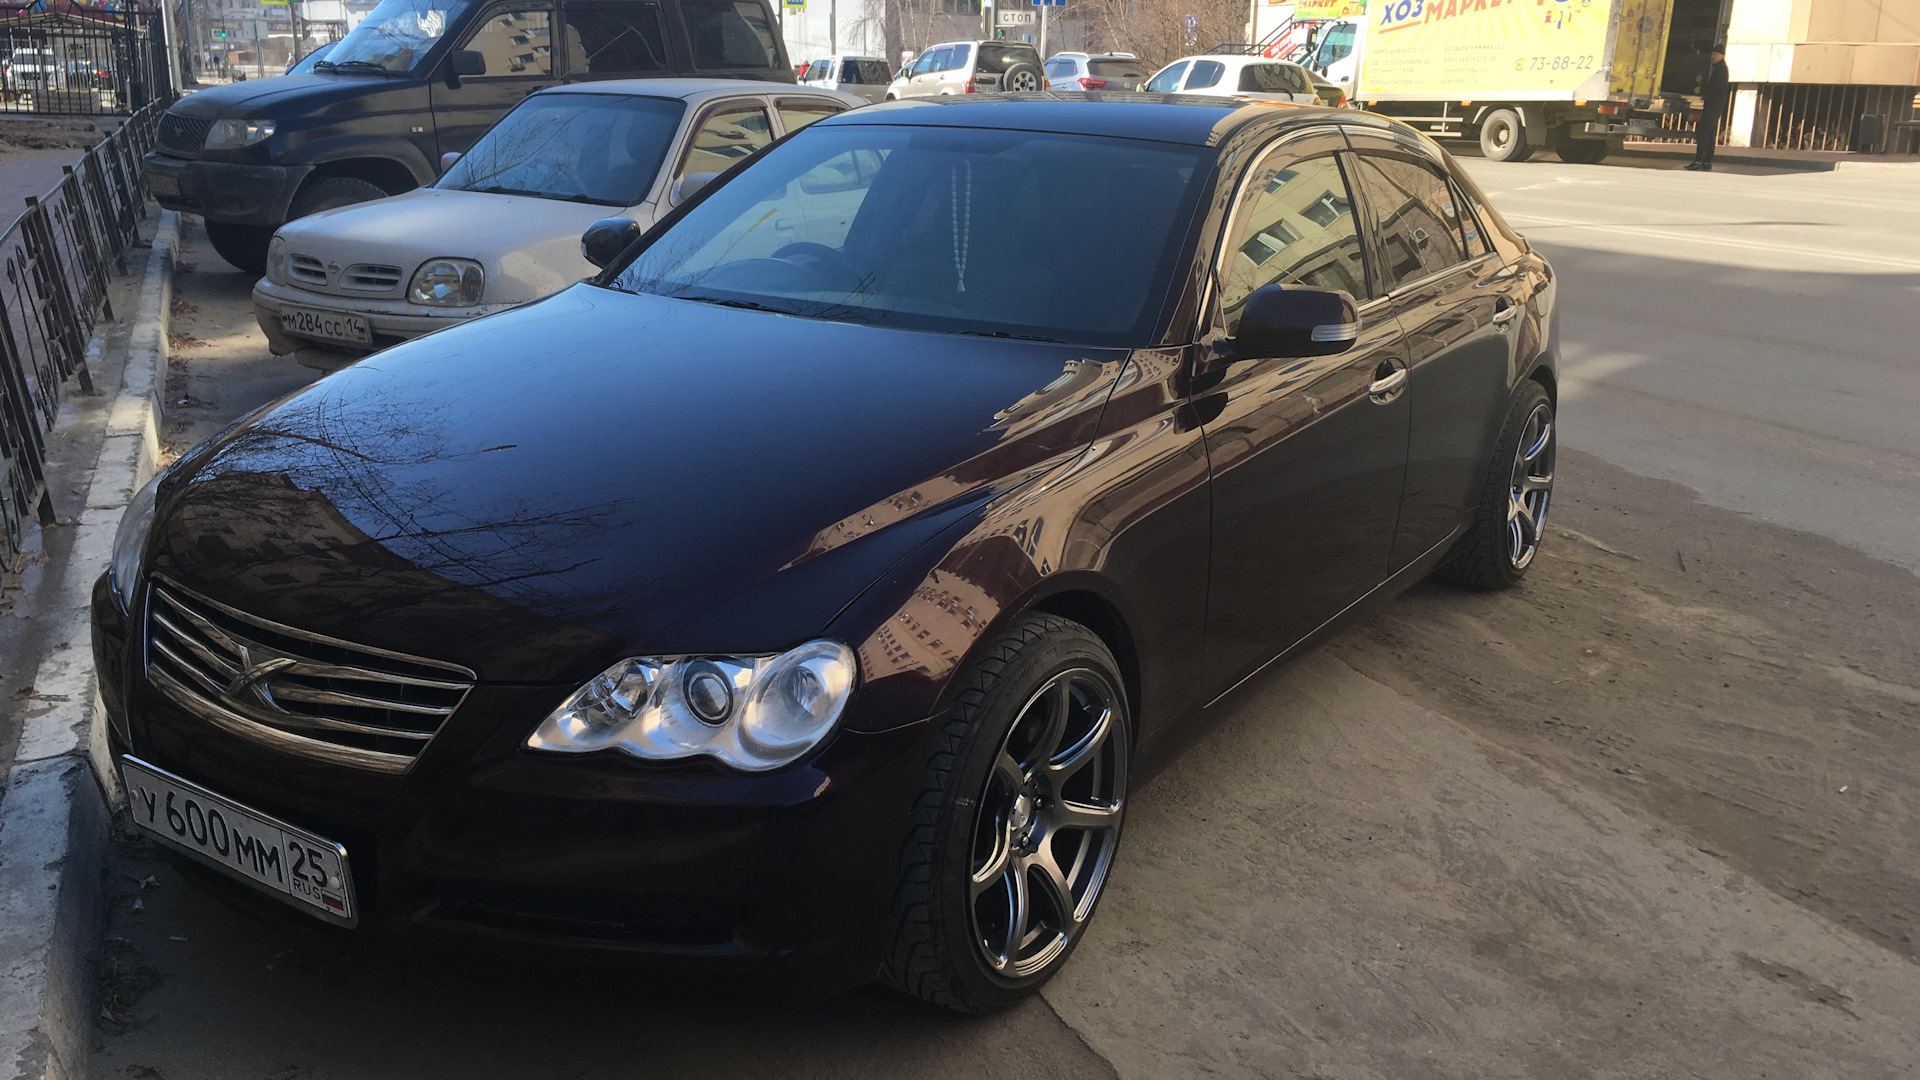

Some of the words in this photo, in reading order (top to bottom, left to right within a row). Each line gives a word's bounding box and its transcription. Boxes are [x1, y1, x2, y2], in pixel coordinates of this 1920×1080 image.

[1003, 13, 1031, 23] СТОП
[1529, 55, 1594, 71] 73-88-22
[287, 311, 343, 337] М284СС
[346, 318, 360, 333] 14
[140, 786, 284, 883] У600ММ
[289, 841, 329, 888] 25
[293, 881, 322, 901] RUS
